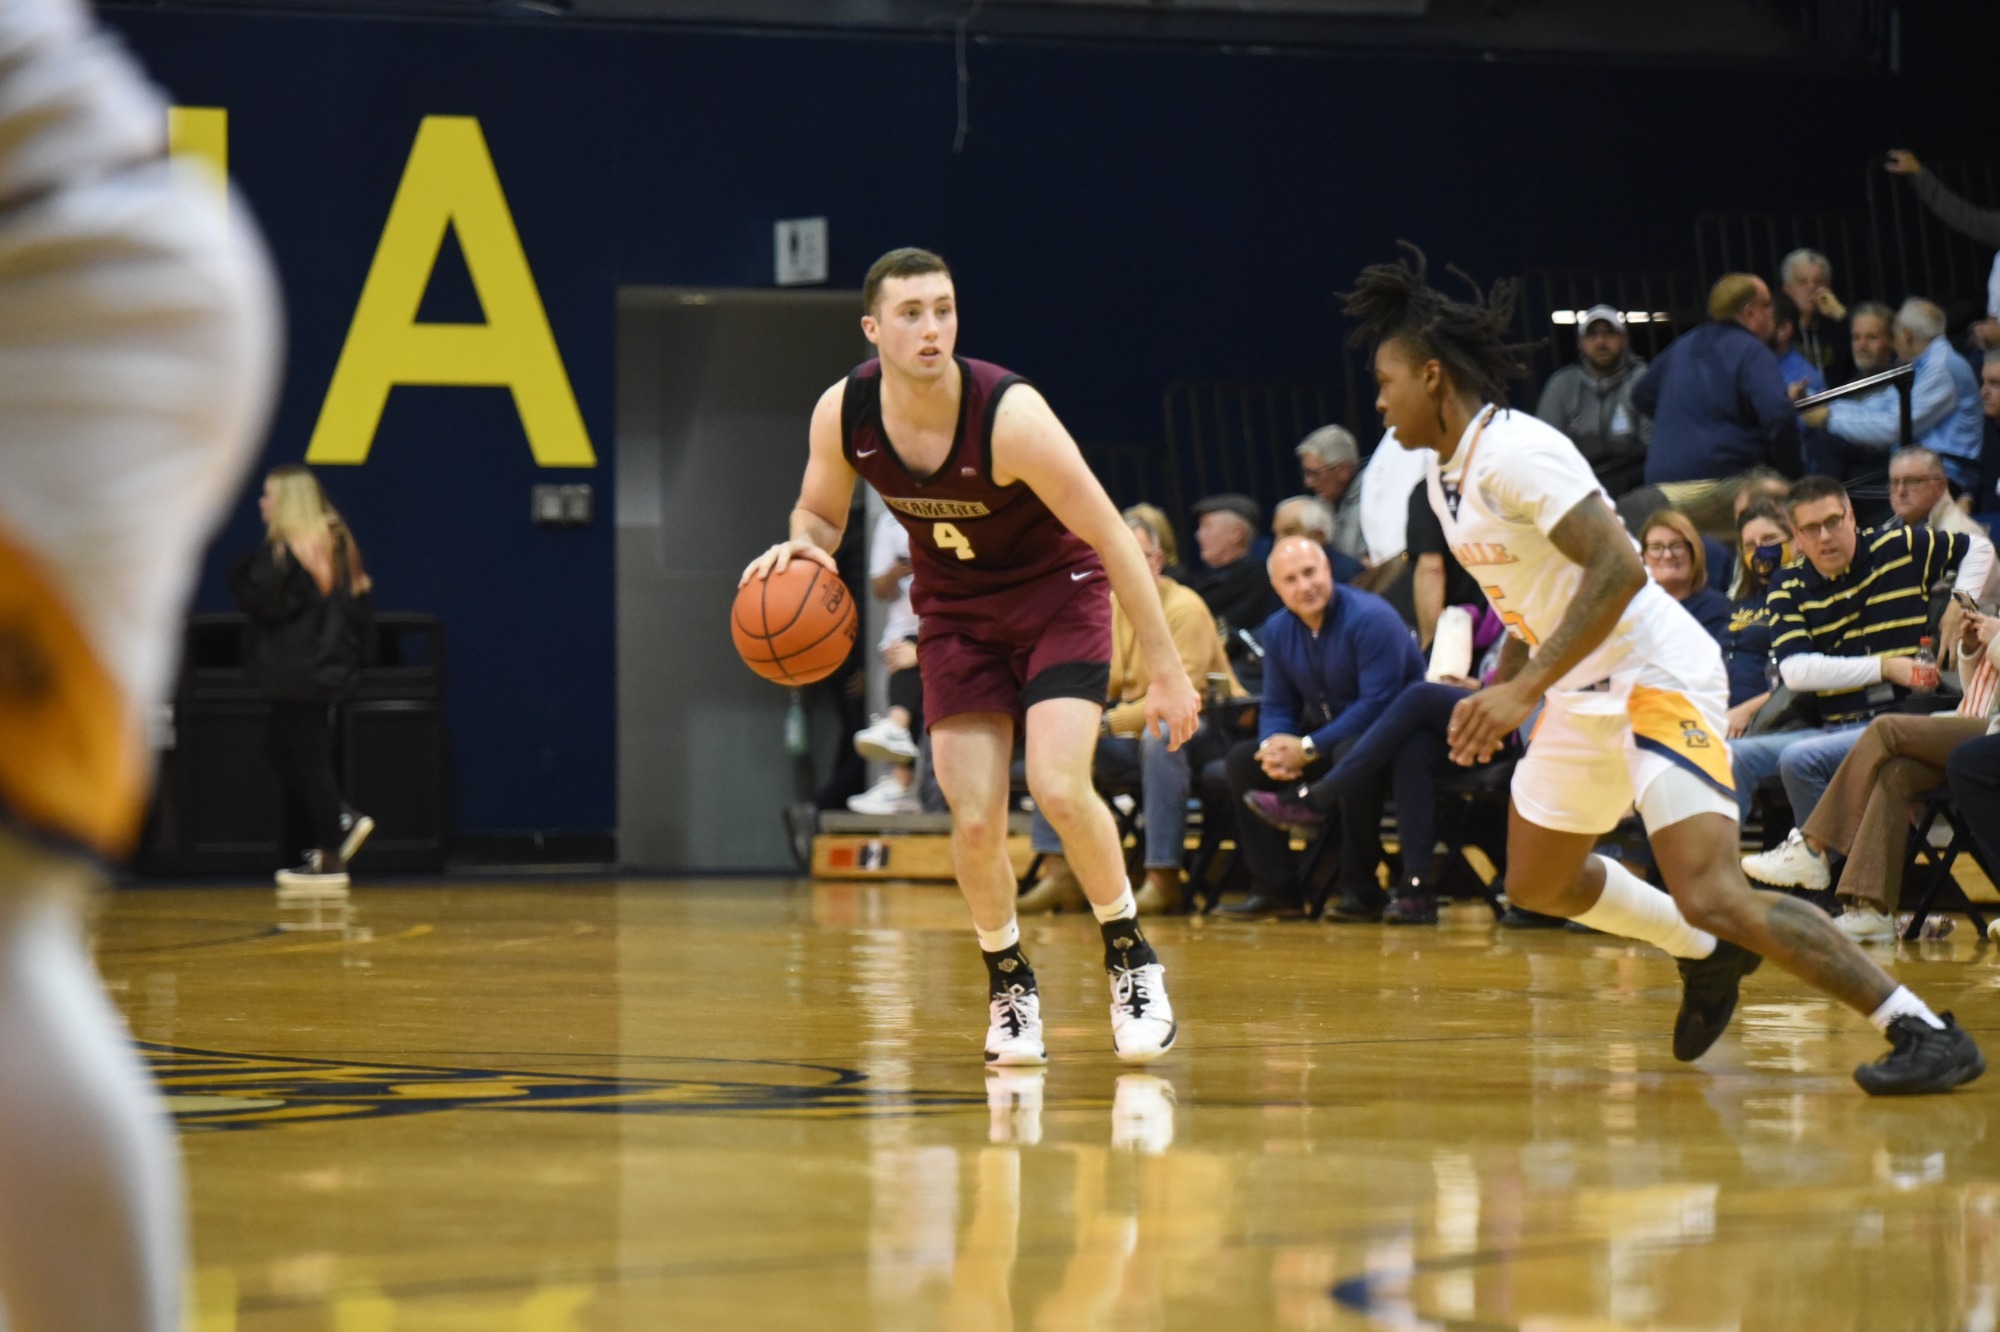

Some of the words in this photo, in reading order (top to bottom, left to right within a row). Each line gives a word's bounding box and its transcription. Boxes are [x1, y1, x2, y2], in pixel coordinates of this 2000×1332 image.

[168, 106, 597, 467] A
[889, 499, 984, 517] FAYETTE
[933, 522, 975, 560] 4
